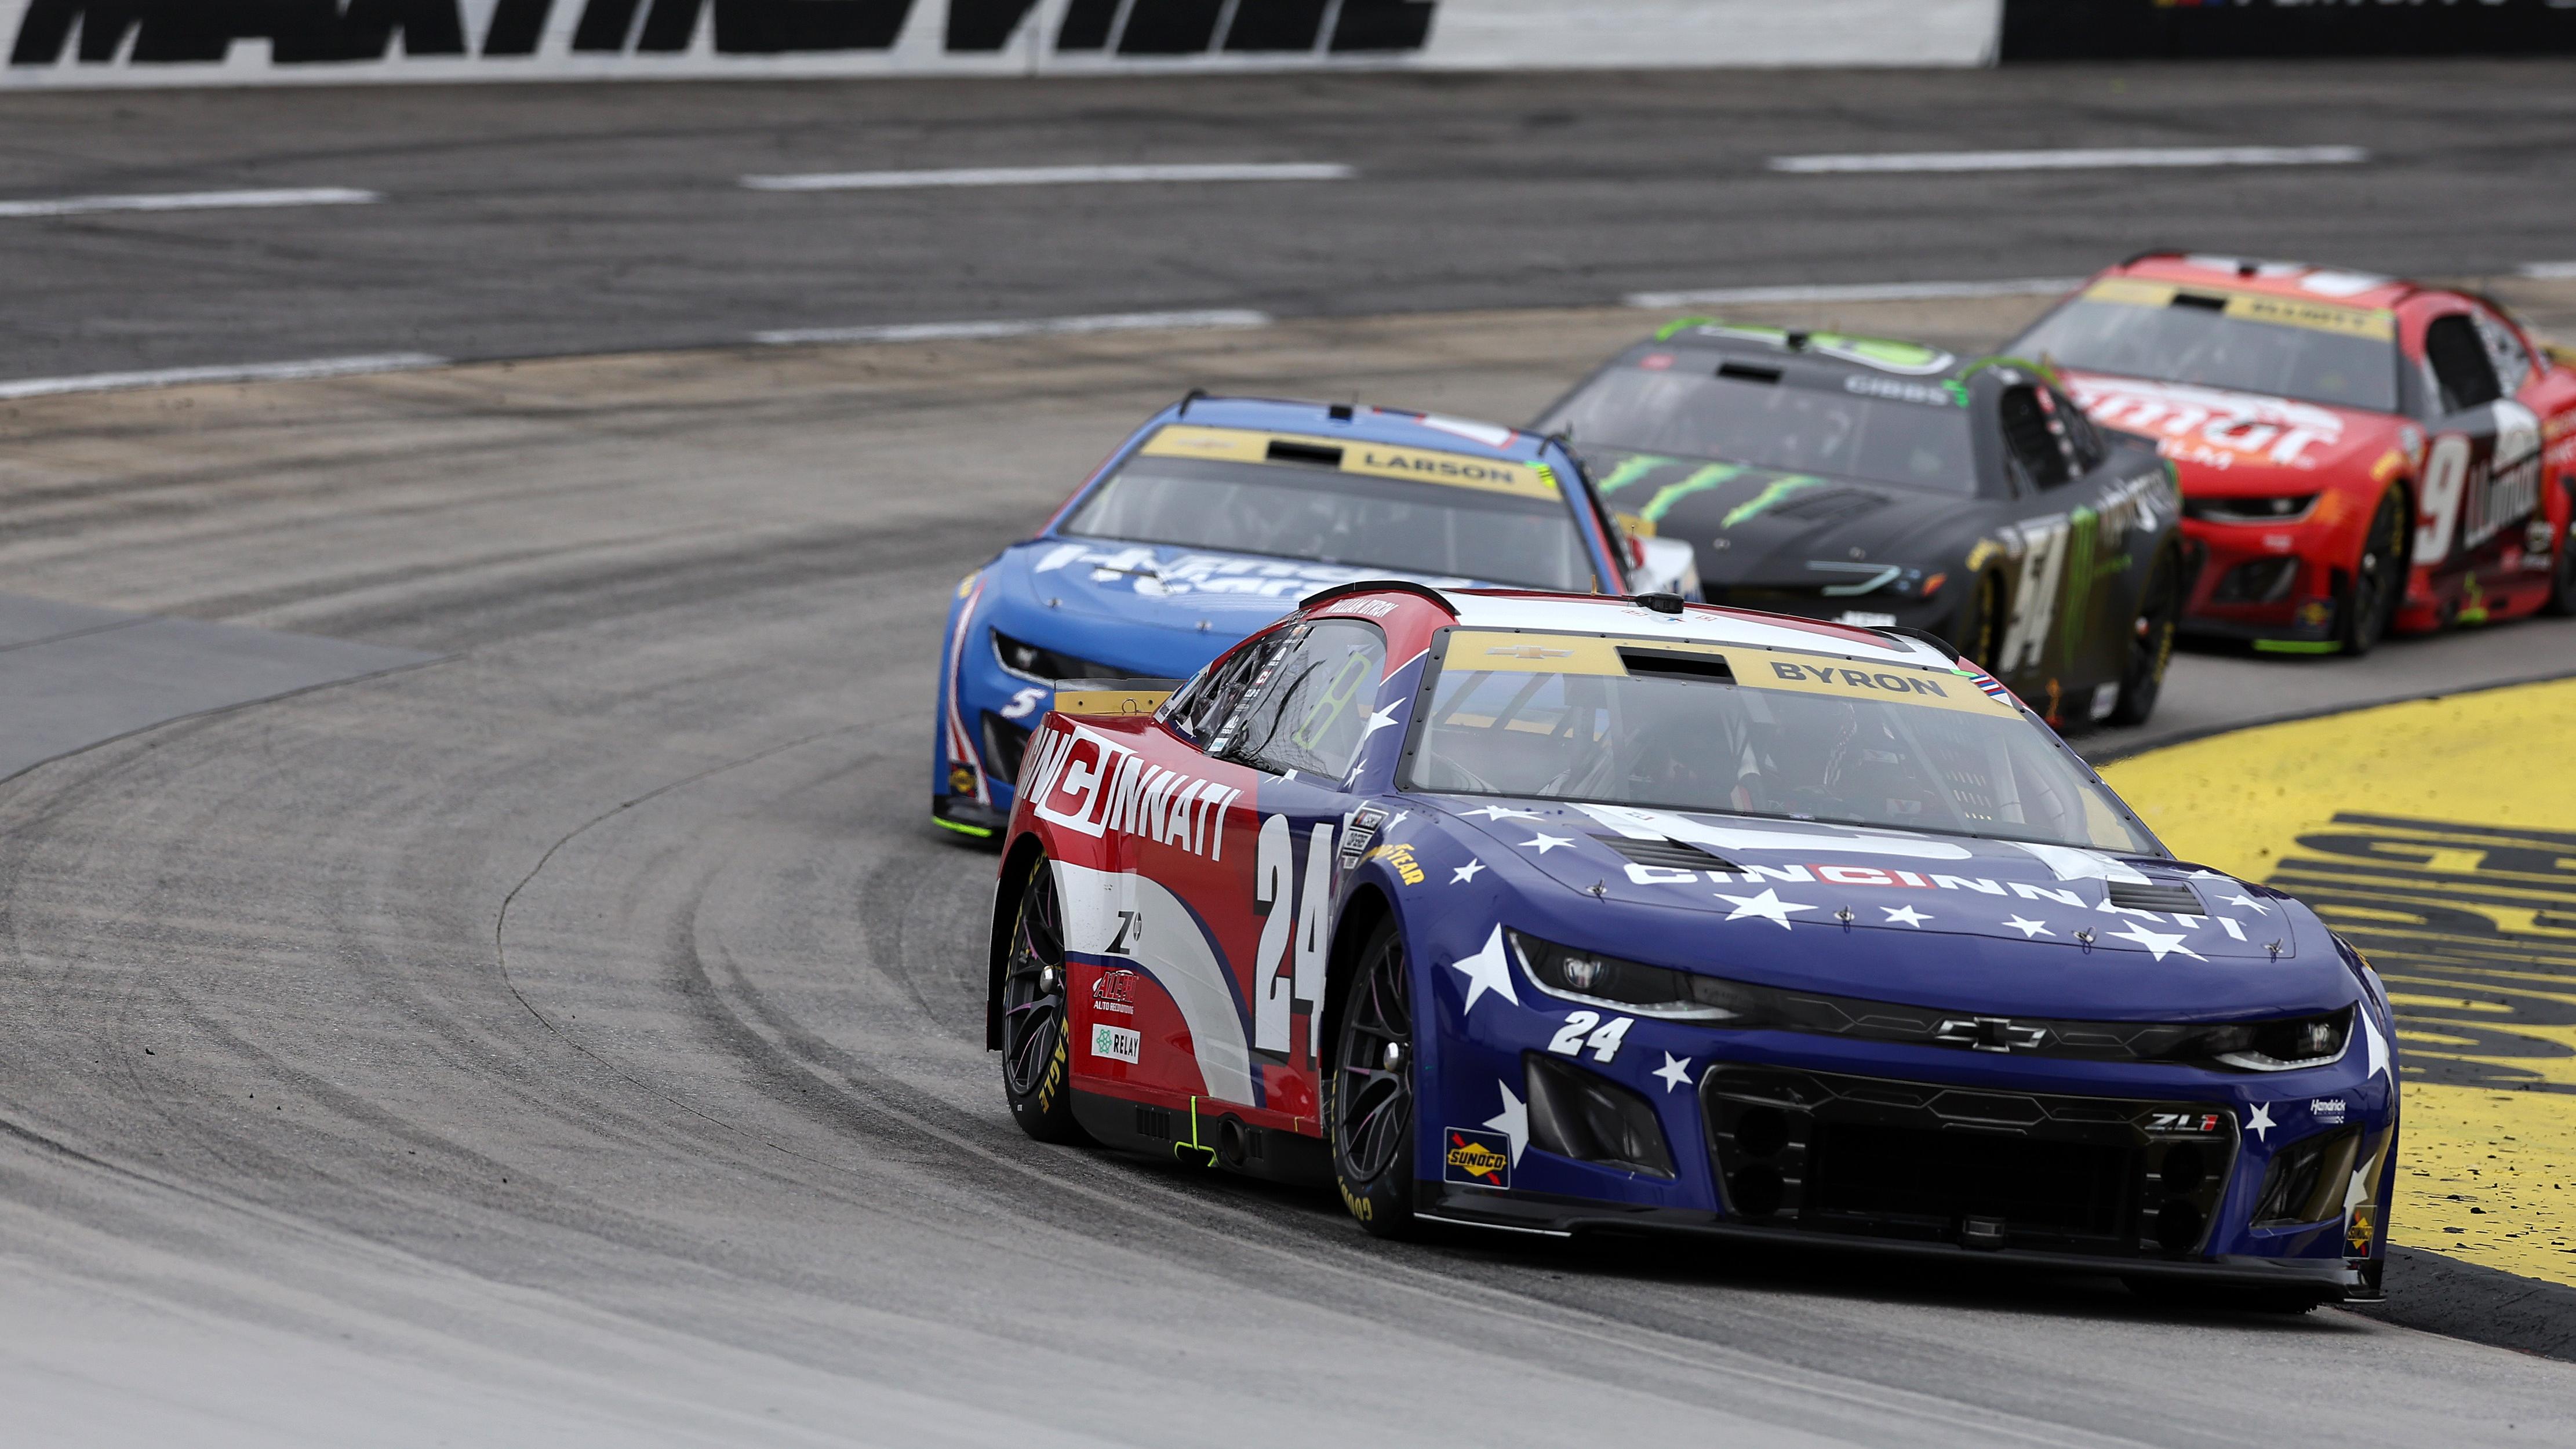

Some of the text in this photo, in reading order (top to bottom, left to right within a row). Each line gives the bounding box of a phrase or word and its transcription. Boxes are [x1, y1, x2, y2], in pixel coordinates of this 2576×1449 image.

[1365, 452, 1515, 485] LARSON
[2411, 435, 2471, 565] 9
[1325, 598, 1399, 618] WILLIAM BYRON
[1770, 661, 1948, 697] BYRON
[1000, 687, 1049, 719] 5
[1254, 813, 1335, 1058] 24
[1093, 1000, 1109, 1011] AUTO
[1114, 1034, 1138, 1057] RELAY
[1547, 1010, 1635, 1063] 24
[1039, 1015, 1069, 1114] EAGLE
[2146, 1113, 2219, 1132] ZL1
[2310, 1098, 2346, 1115] Hendrick
[1450, 1151, 1504, 1168] SUNOCO
